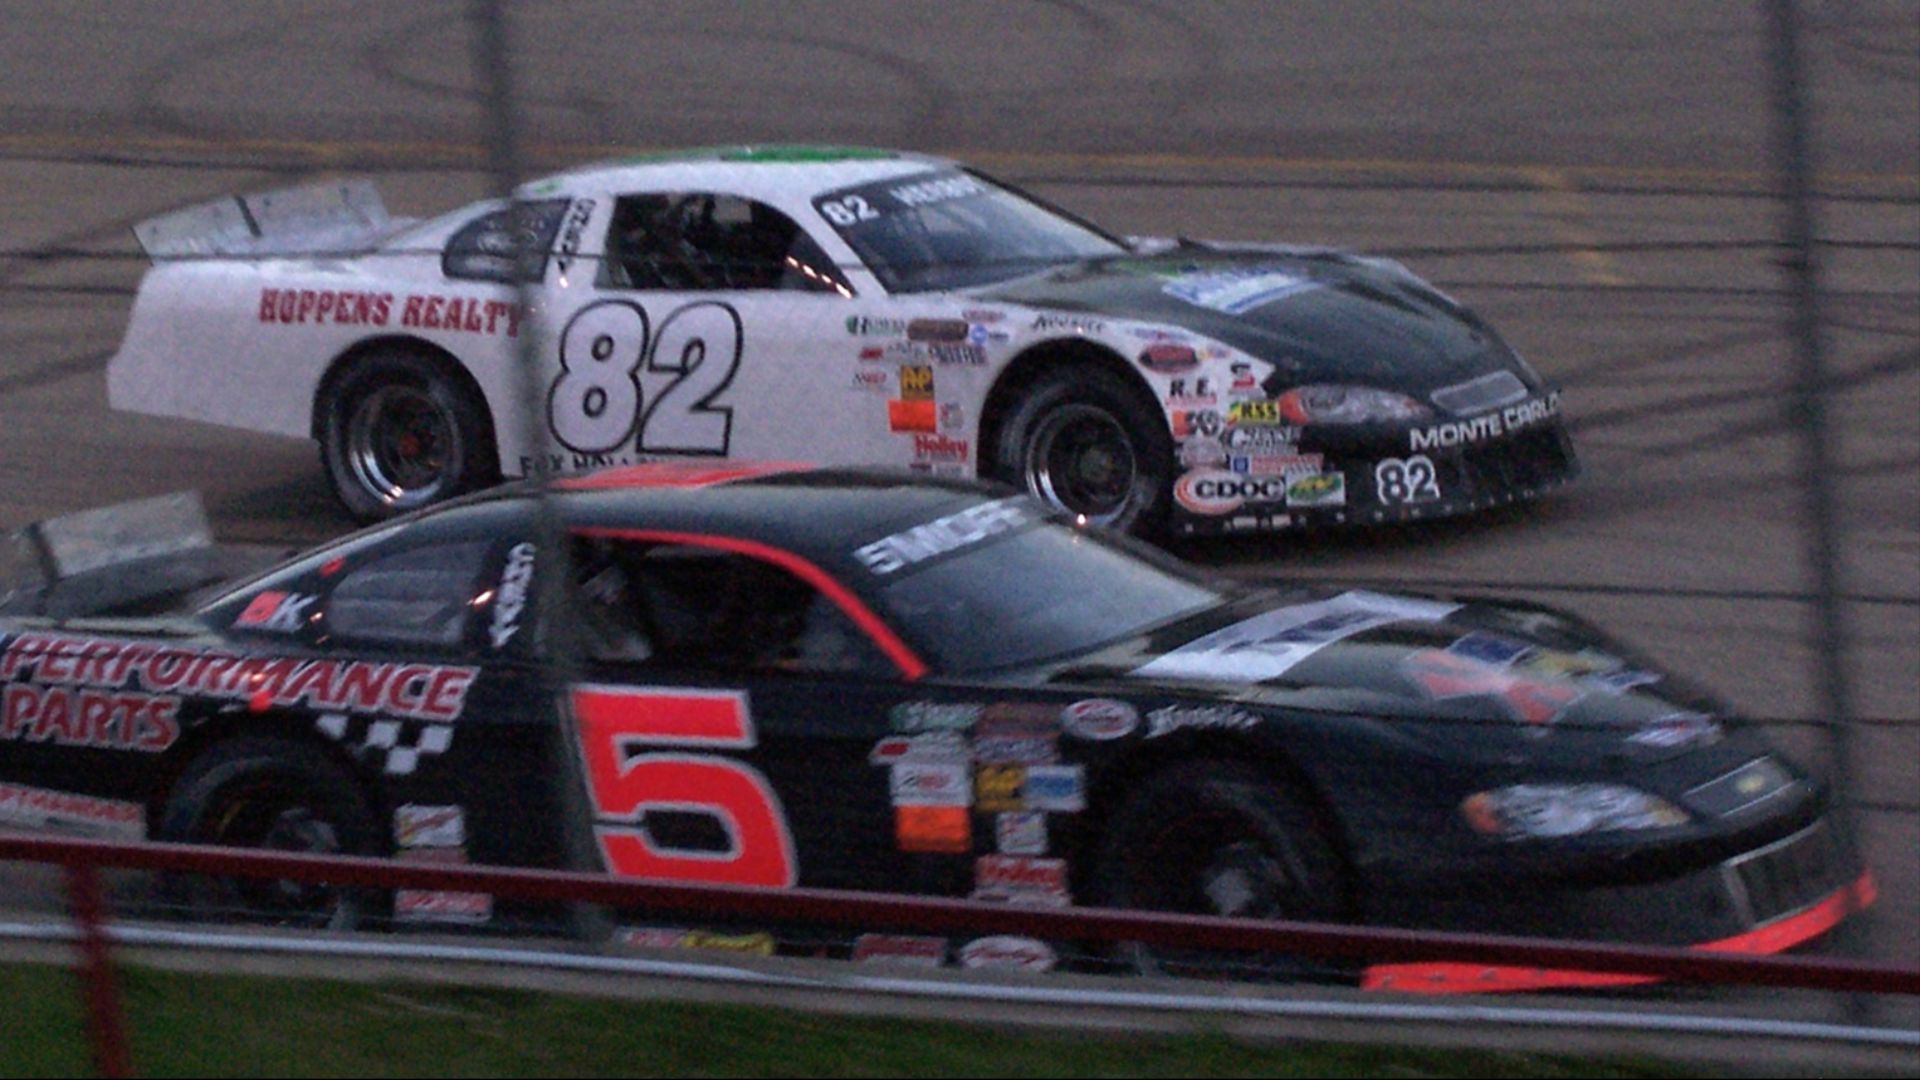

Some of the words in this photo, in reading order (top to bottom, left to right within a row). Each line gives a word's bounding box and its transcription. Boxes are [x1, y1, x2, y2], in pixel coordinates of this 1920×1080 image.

[821, 195, 879, 226] 82
[258, 288, 394, 326] HOPPENS
[402, 294, 524, 338] REALTY
[547, 298, 743, 456] 82
[1409, 414, 1503, 450] MONTE
[1194, 478, 1285, 499] CDOC
[1376, 454, 1441, 505] 82
[0, 632, 481, 722] PERFORMANCE
[0, 684, 182, 752] PARTS
[570, 683, 799, 889] 5
